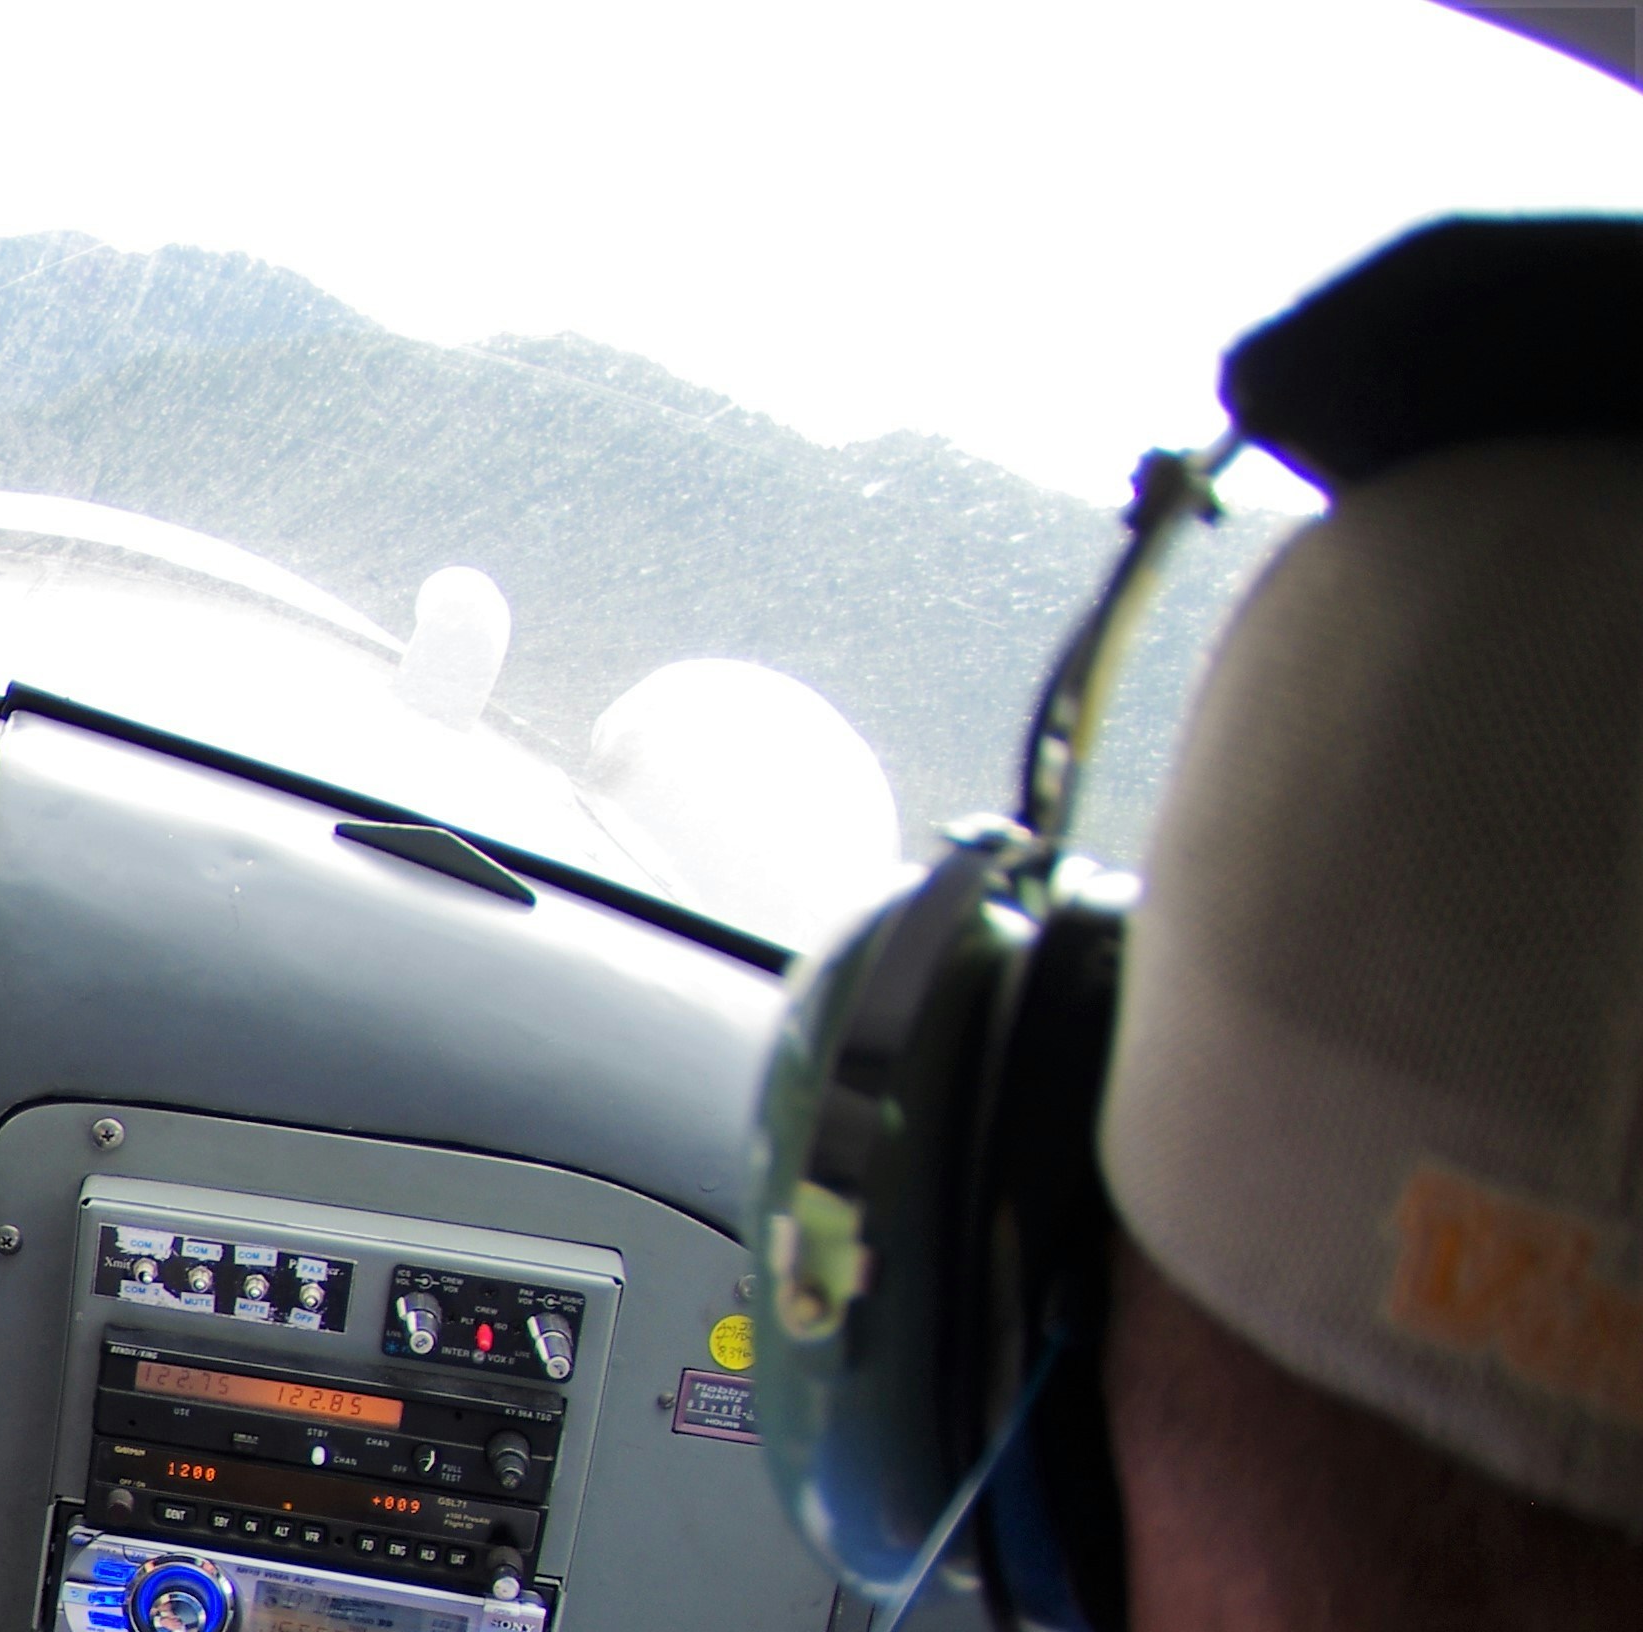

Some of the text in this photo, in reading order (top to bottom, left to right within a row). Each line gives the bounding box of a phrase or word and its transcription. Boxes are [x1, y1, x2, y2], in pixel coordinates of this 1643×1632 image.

[130, 1239, 152, 1249] COM
[186, 1245, 208, 1255] COM
[238, 1252, 260, 1260] COM
[302, 1263, 323, 1274] PAX
[124, 1286, 146, 1294] COM
[185, 1298, 211, 1307] MUTE
[238, 1303, 265, 1314] MUTE
[475, 1306, 499, 1315] CREW
[294, 1313, 314, 1323] OFF
[442, 1347, 506, 1363] INTER VOX
[144, 1365, 230, 1394] 122.75
[695, 1382, 750, 1398] Hobbs
[278, 1386, 361, 1415] 122.85
[174, 1408, 190, 1416] USE
[536, 1412, 551, 1422] TSO
[705, 1418, 740, 1428] HOURS
[168, 1462, 215, 1481] 1200
[373, 1496, 420, 1514] +009
[215, 1517, 228, 1527] SBY
[246, 1522, 257, 1532] ON
[275, 1527, 289, 1536] ALT
[491, 1619, 534, 1632] SONY
